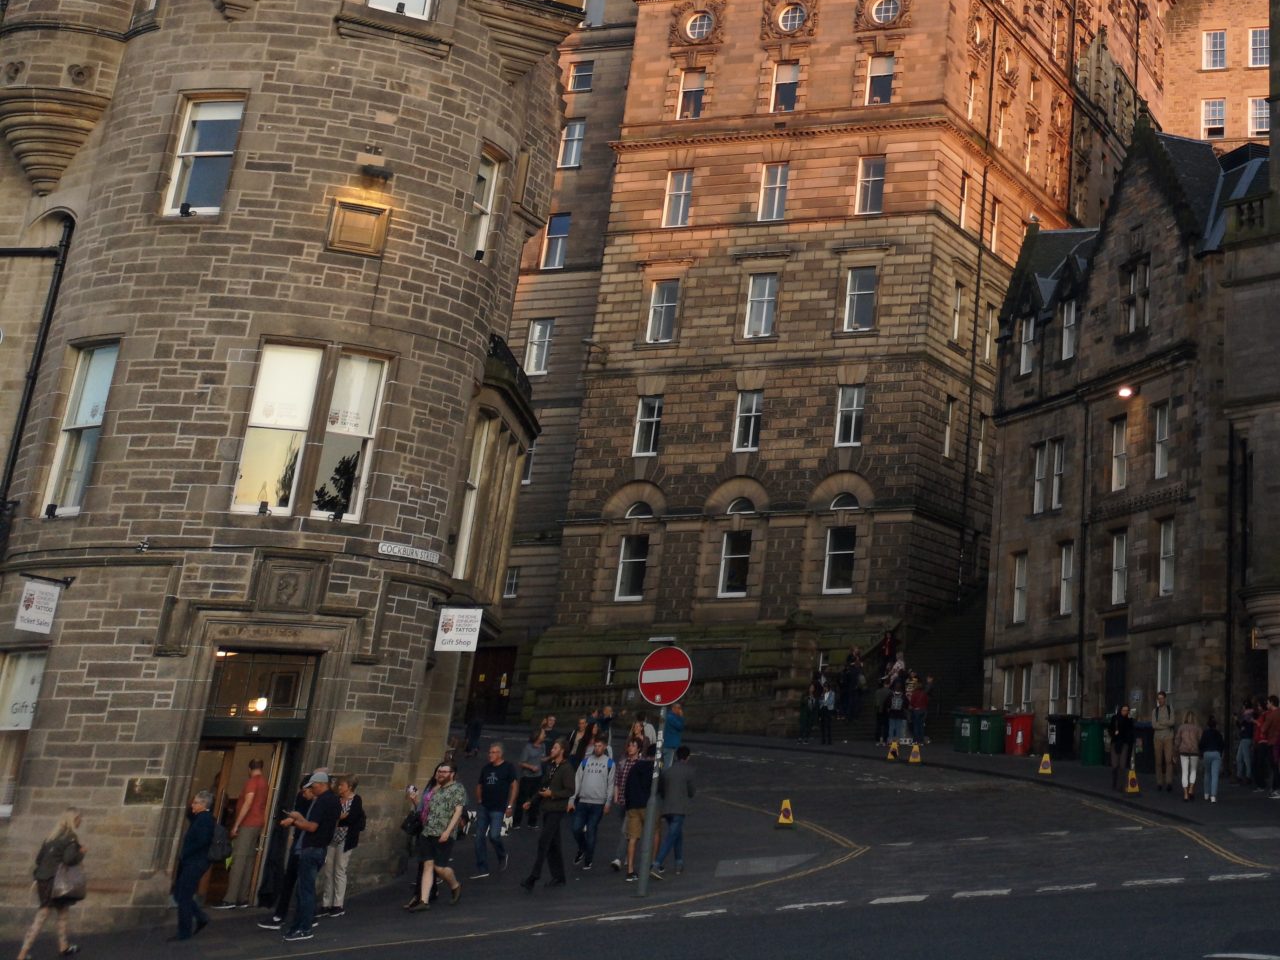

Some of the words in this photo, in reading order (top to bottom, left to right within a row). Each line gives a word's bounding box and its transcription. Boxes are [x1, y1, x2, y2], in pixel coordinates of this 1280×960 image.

[380, 544, 418, 558] COCKBURN
[420, 550, 439, 563] STREET
[441, 638, 454, 646] Gift
[455, 638, 472, 648] Shop
